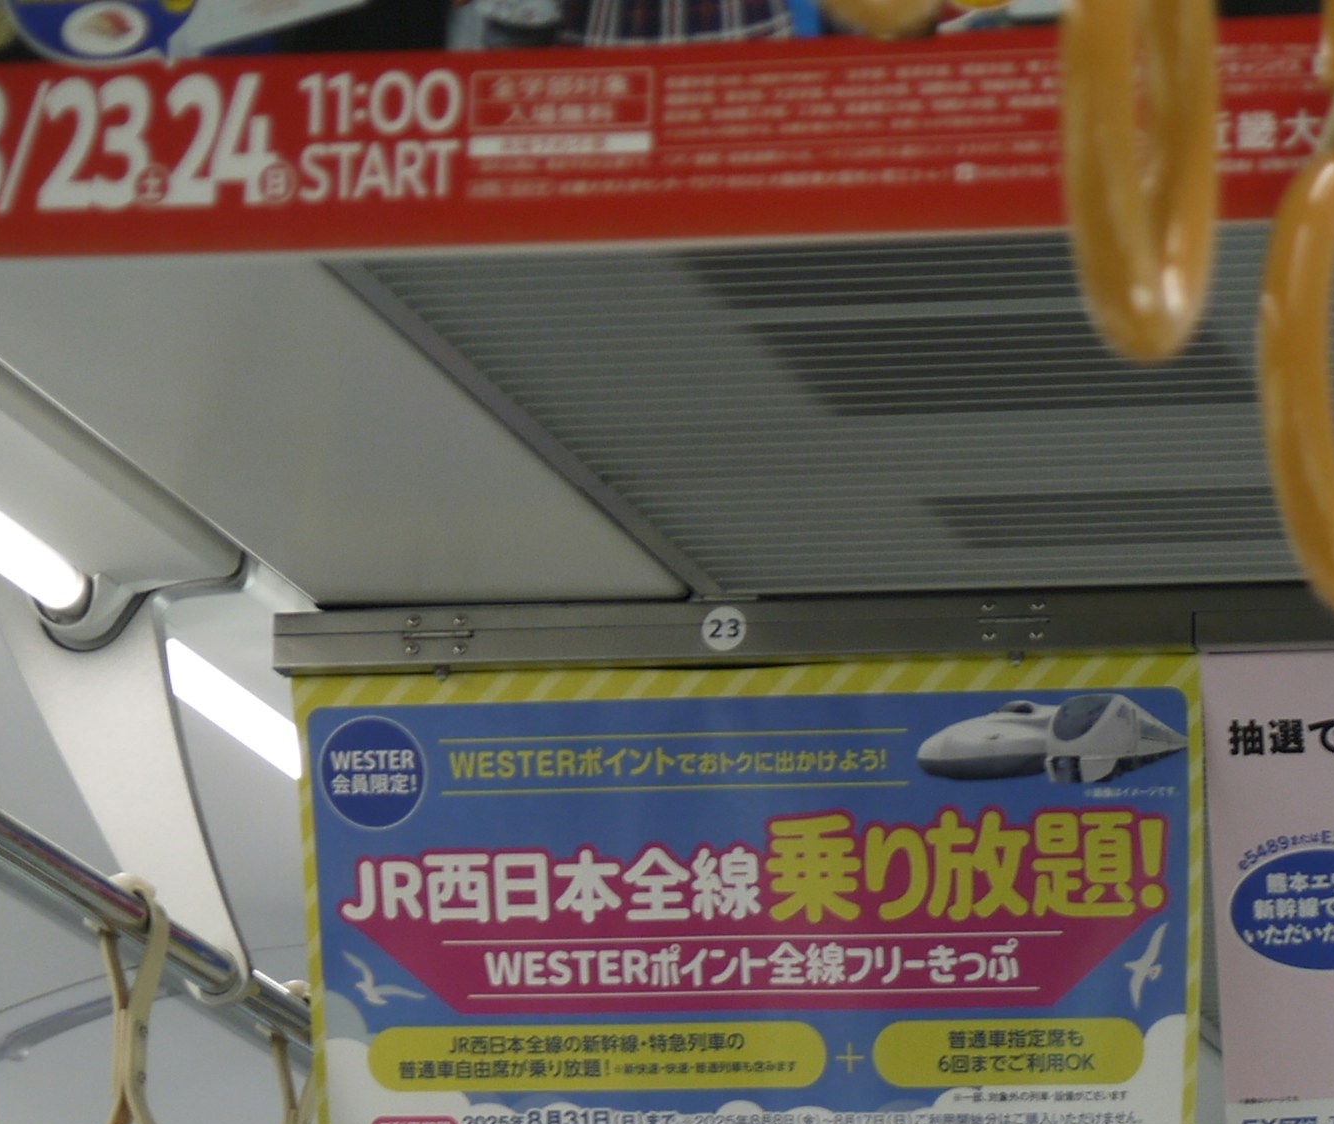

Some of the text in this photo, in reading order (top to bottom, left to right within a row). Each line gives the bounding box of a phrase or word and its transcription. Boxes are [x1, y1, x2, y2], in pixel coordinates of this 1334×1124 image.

[298, 69, 460, 135] 11:00
[166, 73, 276, 206] 24
[299, 140, 459, 201] START
[708, 617, 740, 640] 23
[330, 749, 416, 772] WESTER
[449, 746, 888, 780] WESTERポイントでおトクに出かけよう!
[485, 937, 1020, 988] WESTERポイント全線フリーきっぷ
[449, 1032, 745, 1055] JR西日本全線の新幹線・特急列車の
[948, 1028, 1084, 1050] 普通車指定席も
[938, 1052, 1096, 1074] 6回までご利用OK
